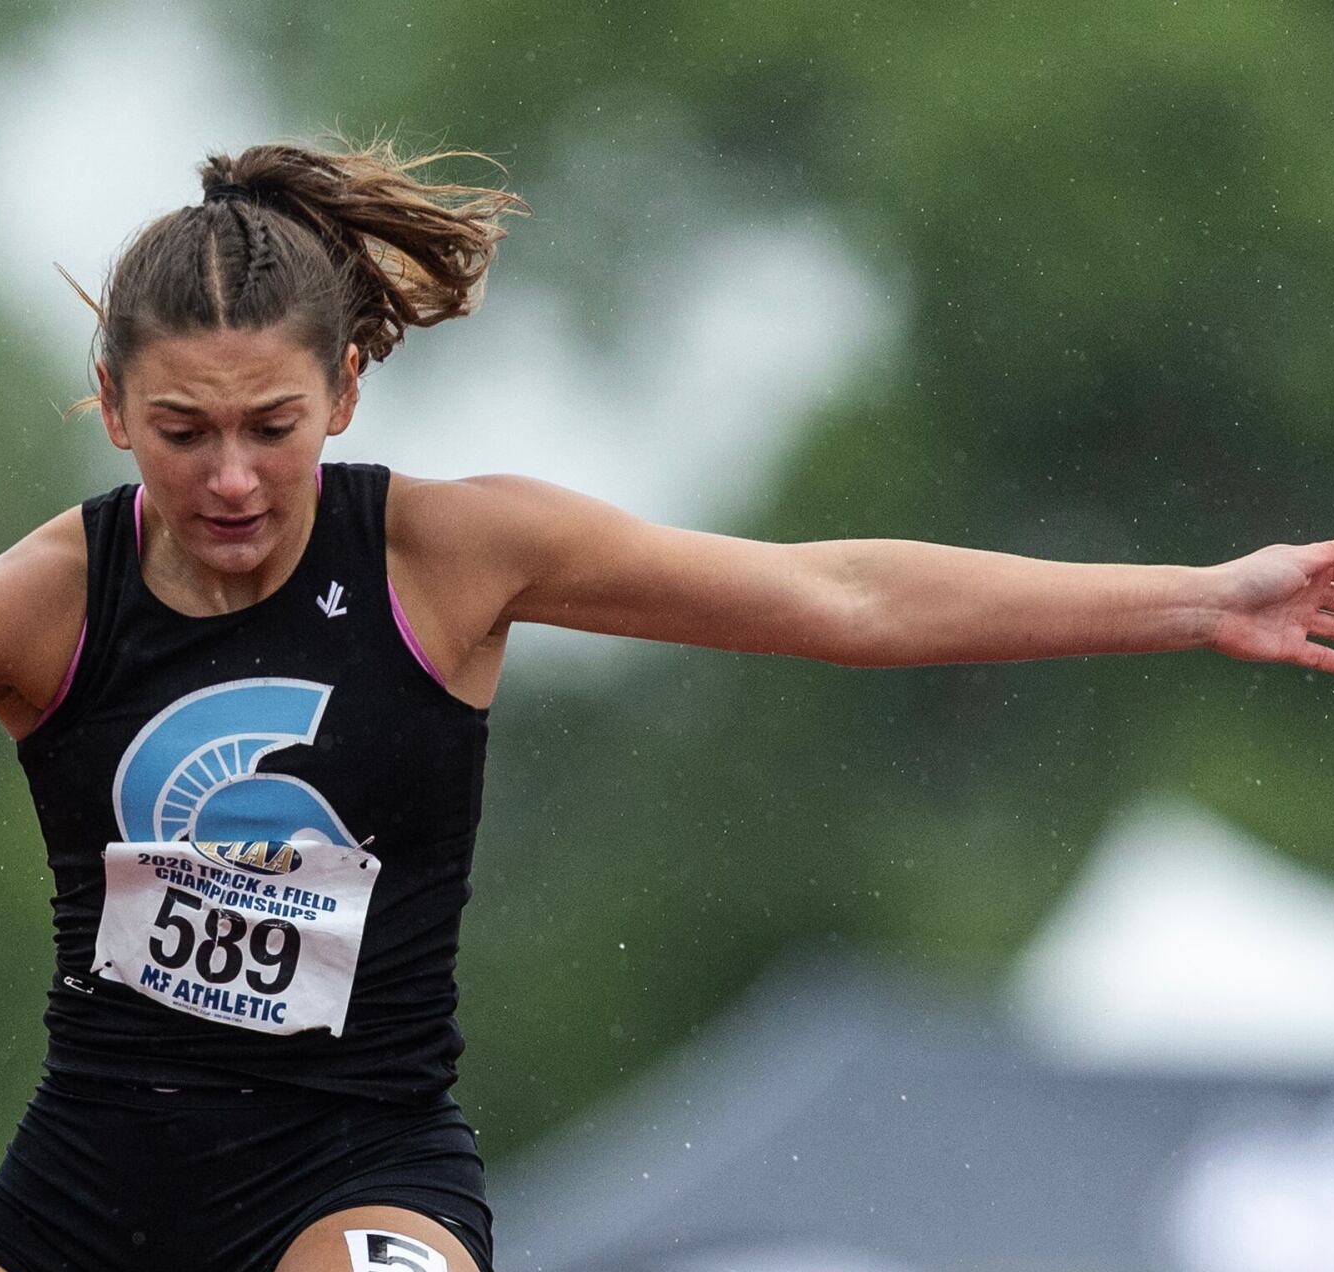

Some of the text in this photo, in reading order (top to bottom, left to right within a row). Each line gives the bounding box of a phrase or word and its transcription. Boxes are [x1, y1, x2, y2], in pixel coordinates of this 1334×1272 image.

[138, 853, 337, 913] 2026 TRACK & FIELD
[155, 867, 317, 921] CHAMPIONSHIPS
[149, 888, 301, 995] 589
[172, 978, 287, 1025] ATHLETIC
